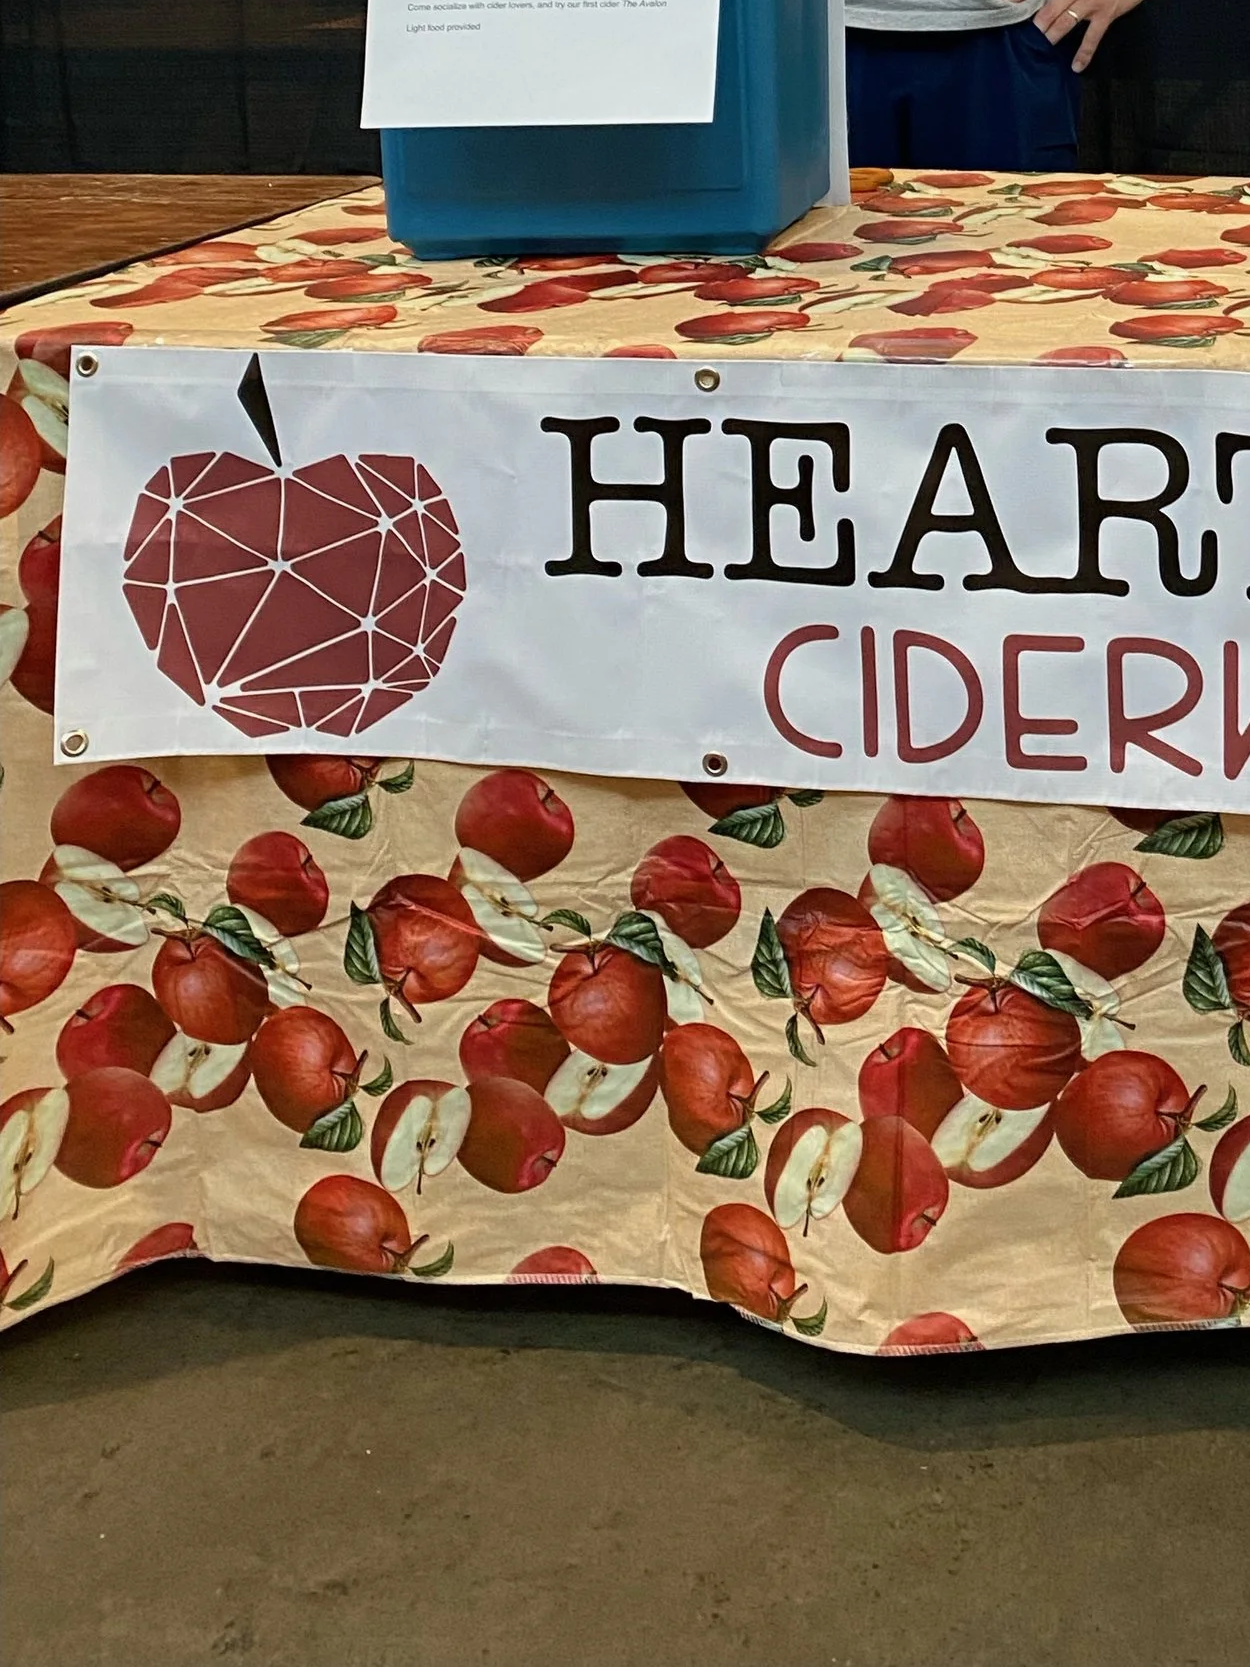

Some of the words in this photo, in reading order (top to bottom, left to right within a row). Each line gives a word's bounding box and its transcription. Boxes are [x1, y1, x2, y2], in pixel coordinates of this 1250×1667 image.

[407, 3, 431, 11] Come
[433, 3, 467, 11] socialize
[468, 2, 485, 10] with
[486, 1, 507, 9] cider
[554, 1, 566, 10] try
[582, 0, 598, 8] first
[599, 0, 620, 8] cider
[623, 0, 638, 8] The
[639, 0, 668, 8] Avalon
[406, 24, 425, 33] Light
[427, 23, 445, 31] food
[446, 23, 481, 33] provided
